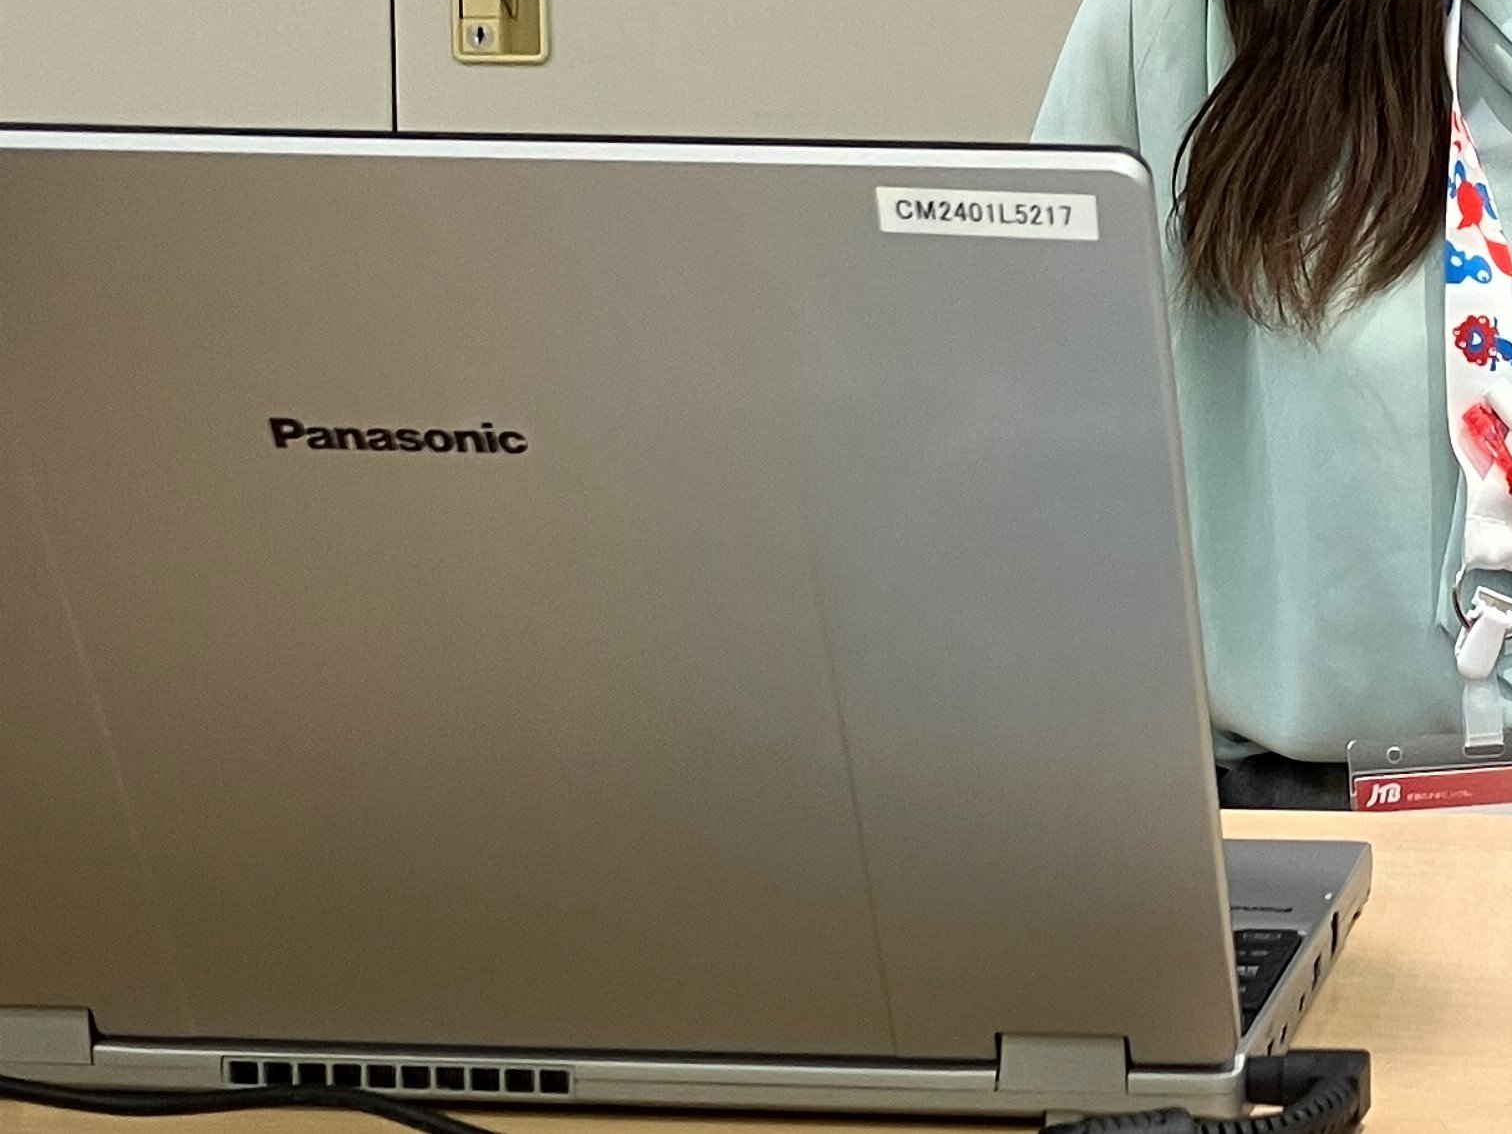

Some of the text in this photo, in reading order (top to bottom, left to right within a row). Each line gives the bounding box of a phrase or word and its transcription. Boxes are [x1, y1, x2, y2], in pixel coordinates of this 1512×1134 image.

[895, 199, 1072, 226] CM2401L5217
[269, 417, 528, 454] Panasonic
[1366, 783, 1401, 808] JTB
